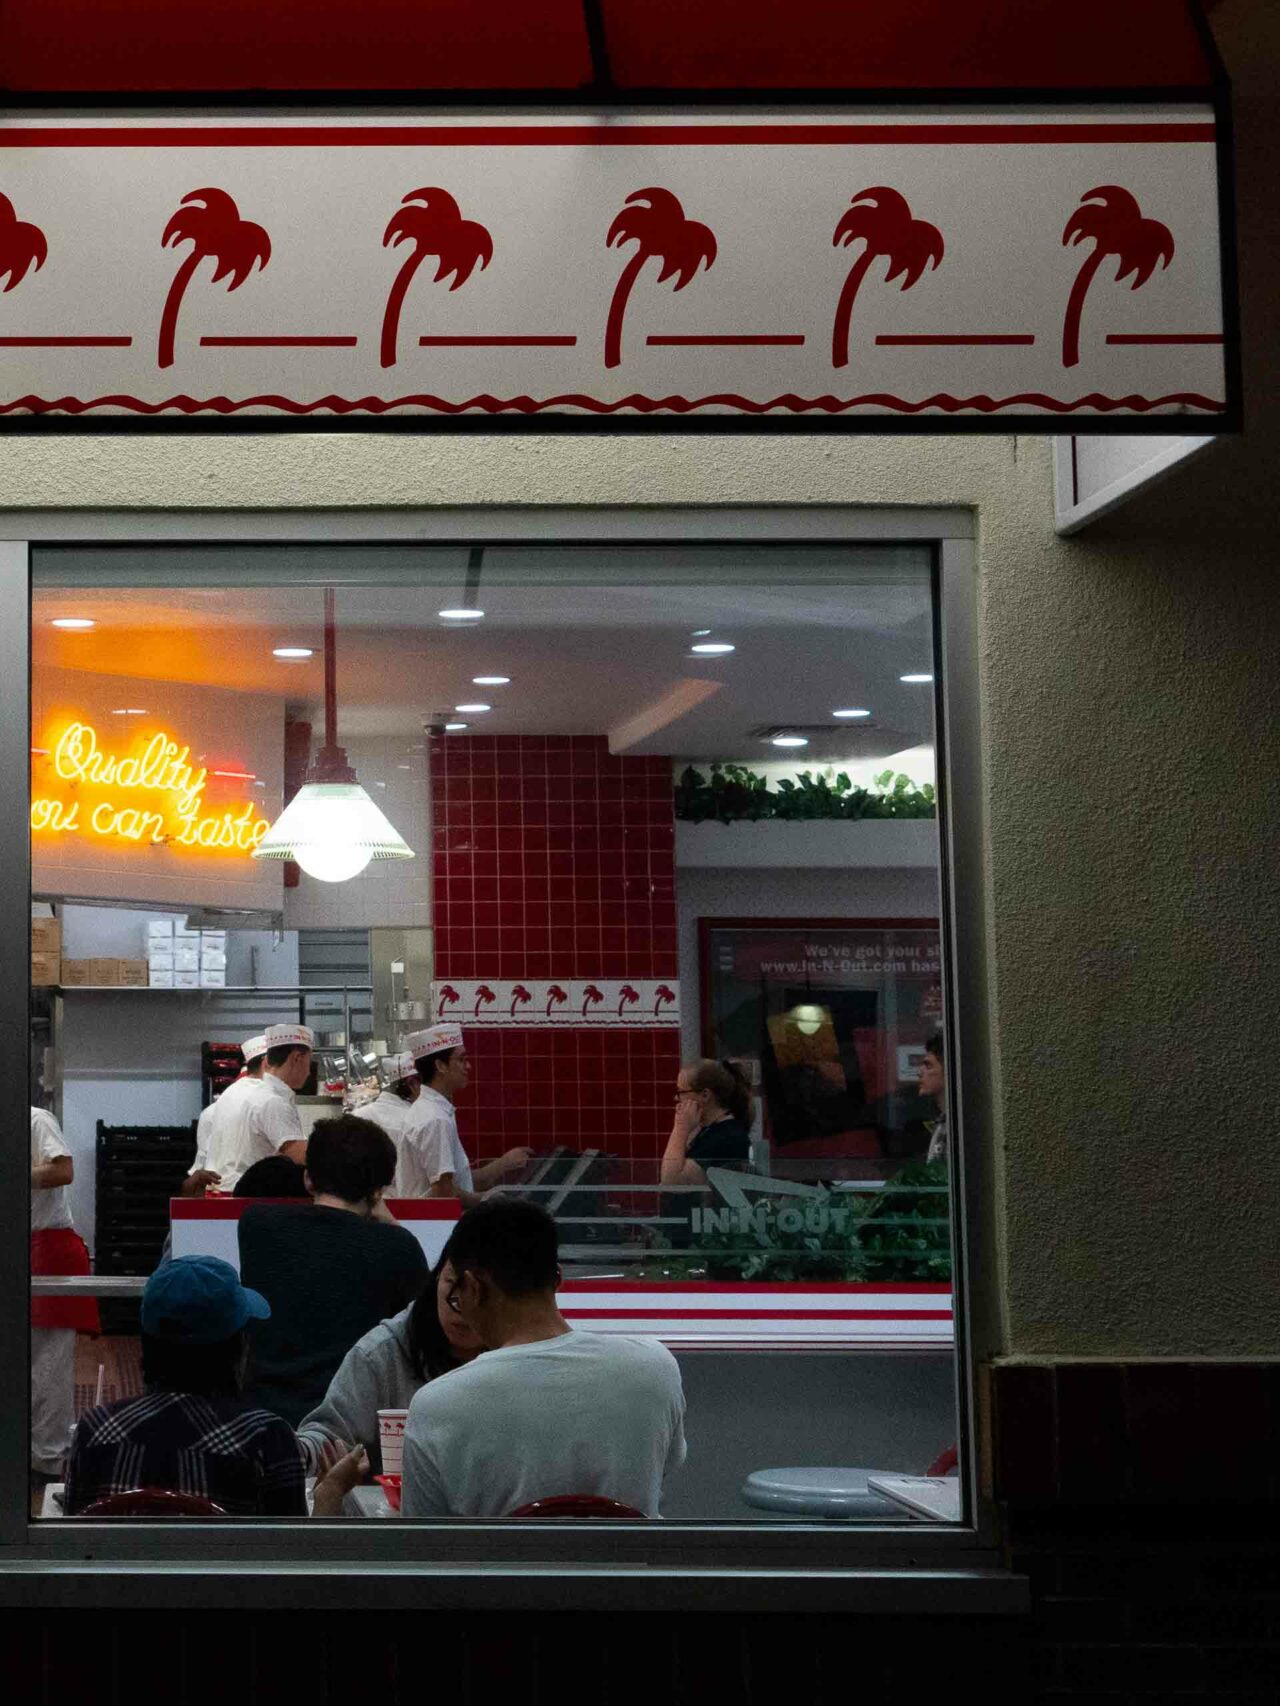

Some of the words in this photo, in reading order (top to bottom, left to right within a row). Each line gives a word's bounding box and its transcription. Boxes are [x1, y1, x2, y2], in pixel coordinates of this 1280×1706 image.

[55, 722, 207, 811] Quality
[31, 799, 79, 831] ou
[92, 803, 164, 842] can
[179, 797, 271, 849] taste
[805, 944, 850, 958] We've
[854, 945, 882, 960] got
[886, 945, 922, 960] your
[691, 1207, 850, 1234] IN-N-OUT
